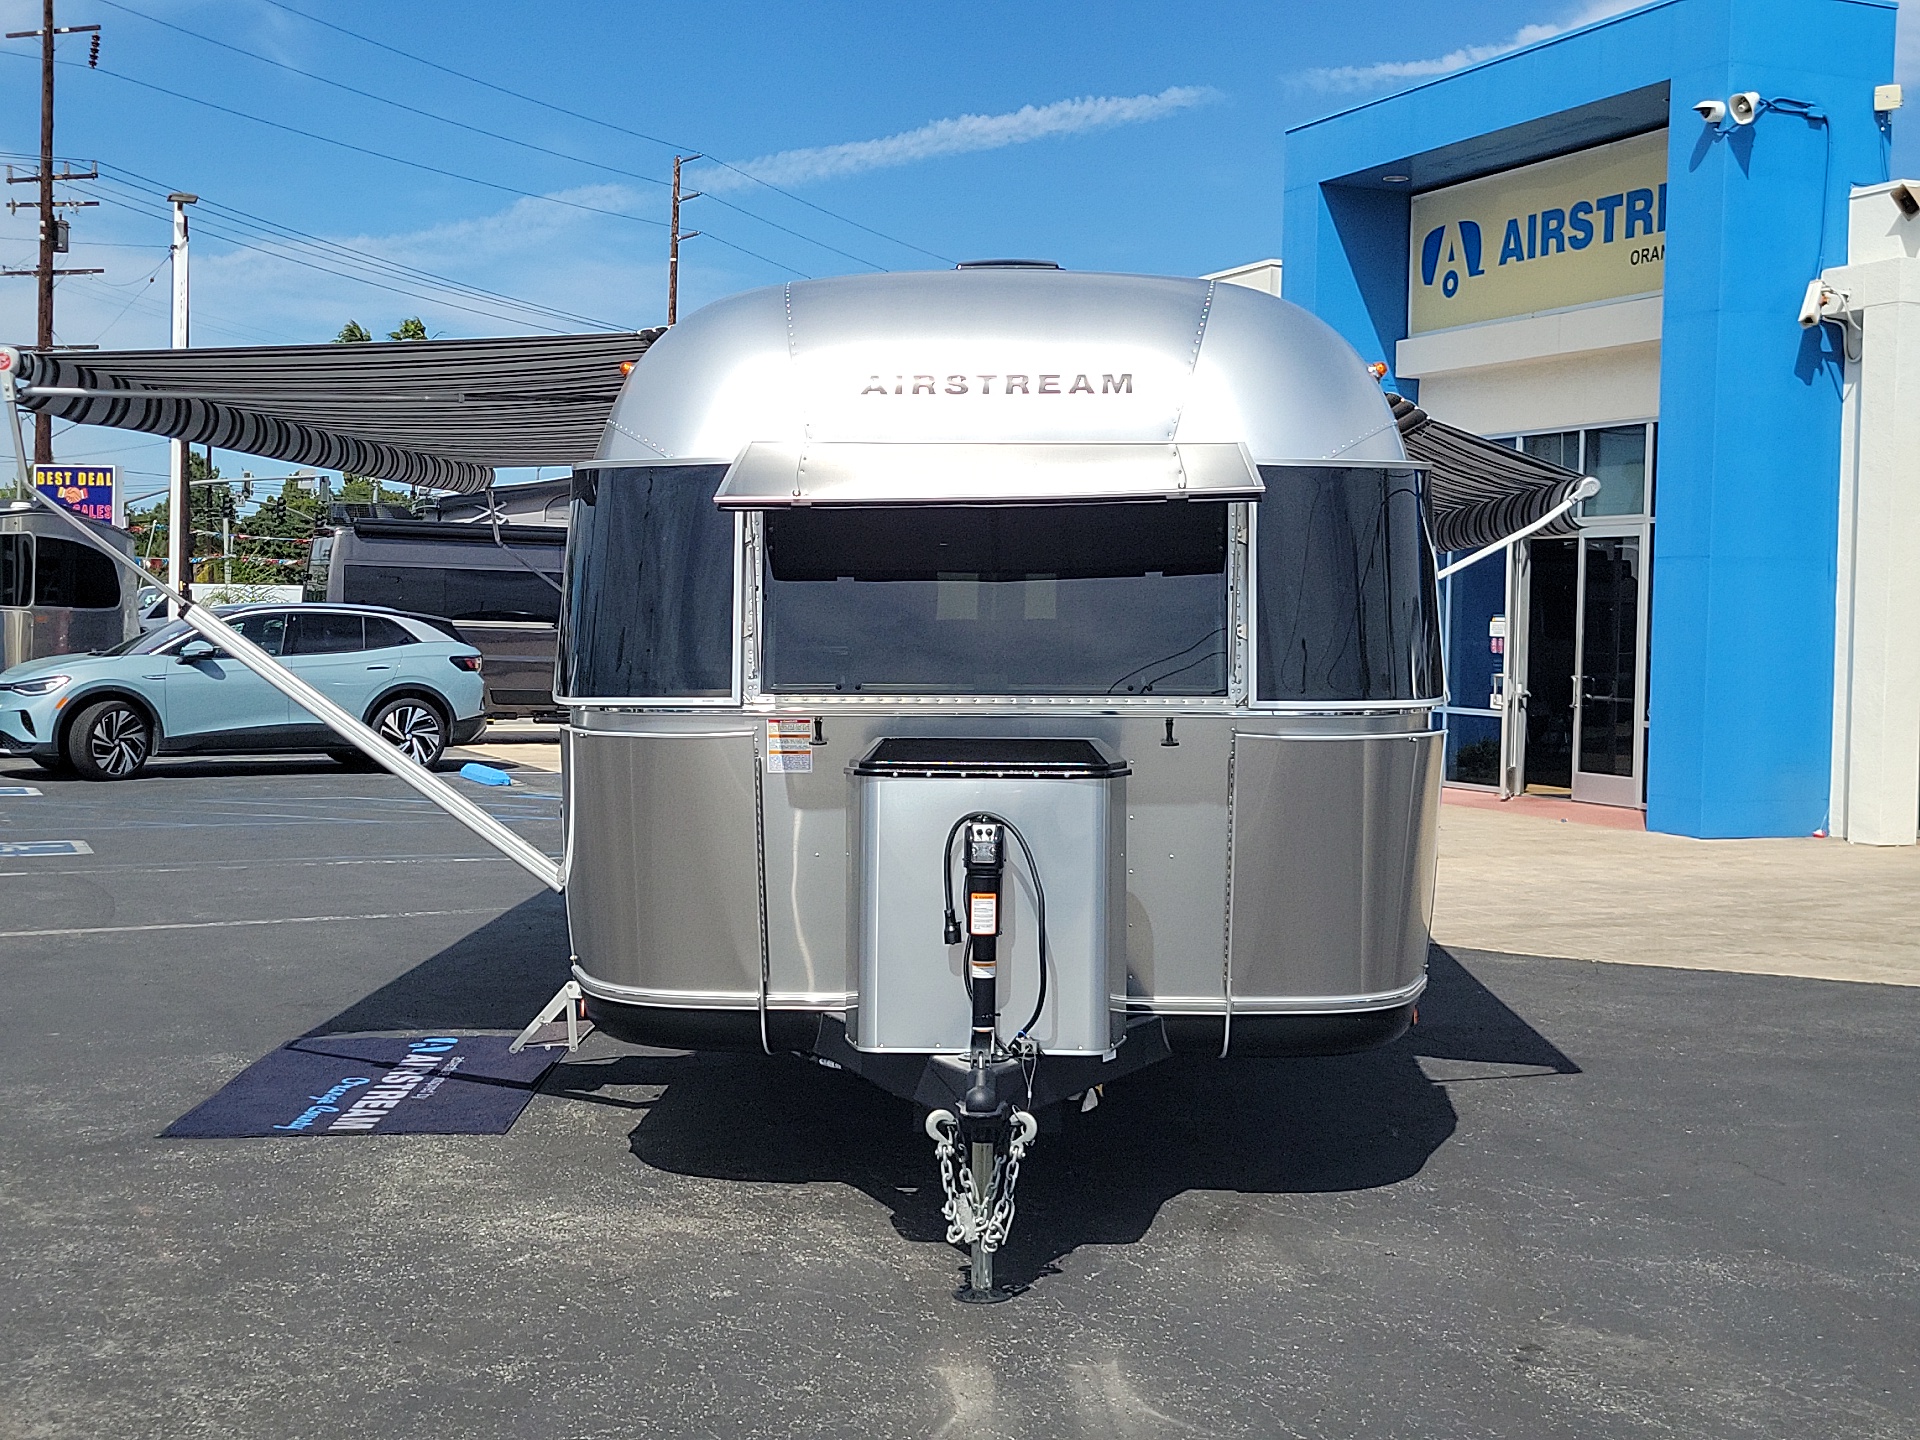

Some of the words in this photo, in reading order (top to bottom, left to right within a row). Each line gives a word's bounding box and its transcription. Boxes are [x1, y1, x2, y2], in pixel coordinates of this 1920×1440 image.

[860, 373, 1133, 395] AIRSTREAM
[36, 471, 72, 486] BEST
[77, 471, 112, 486] DEAL
[308, 1077, 371, 1105] Orange
[327, 1053, 444, 1131] AIRSTREAM
